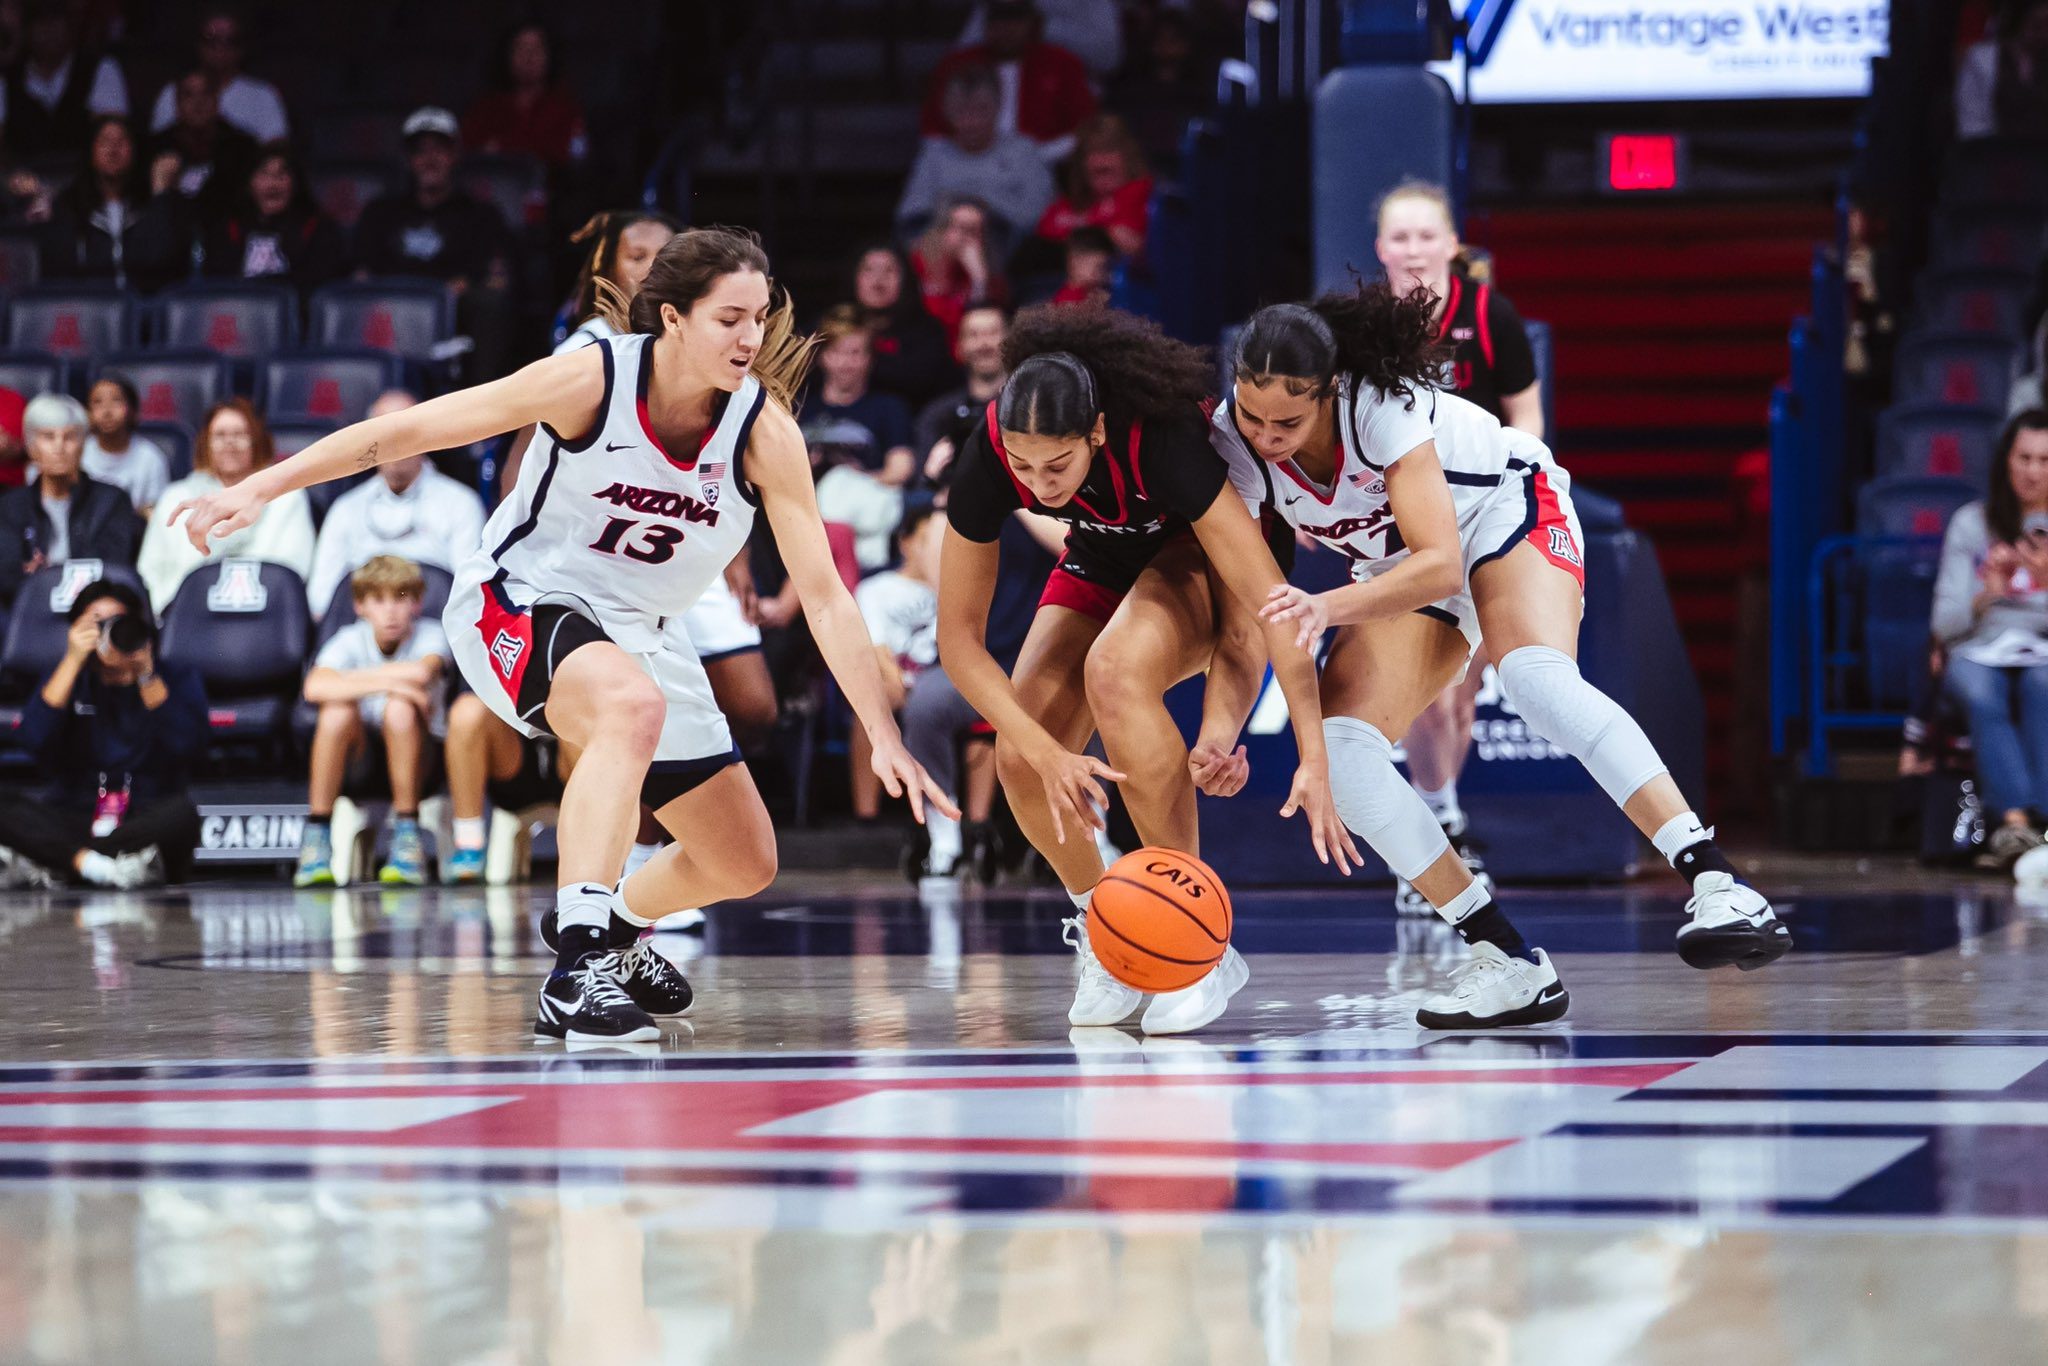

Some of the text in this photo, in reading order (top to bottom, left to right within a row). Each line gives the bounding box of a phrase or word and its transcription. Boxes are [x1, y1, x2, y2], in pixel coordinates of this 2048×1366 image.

[1531, 7, 1744, 55] Vantage
[592, 482, 720, 528] ARIZONA
[1298, 500, 1393, 540] ARIZON
[588, 515, 685, 564] 13
[201, 815, 305, 849] CASIN
[1146, 862, 1206, 898] CATS
